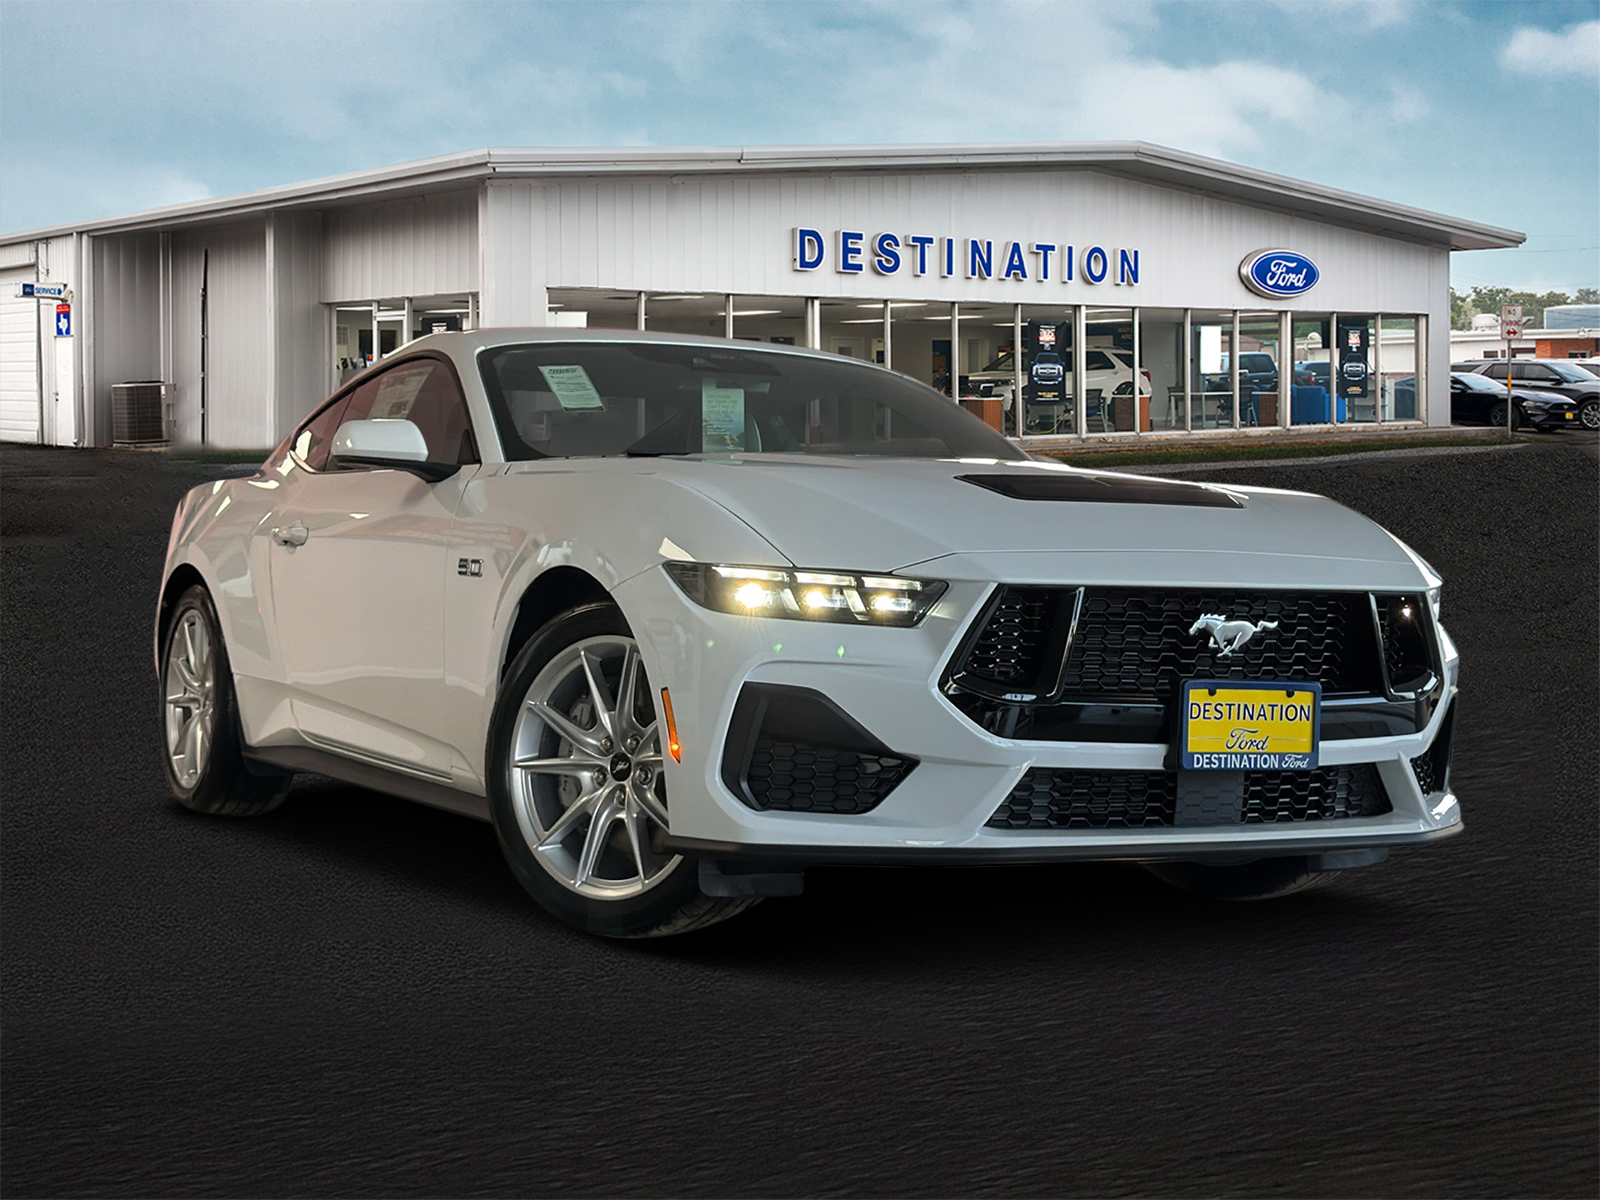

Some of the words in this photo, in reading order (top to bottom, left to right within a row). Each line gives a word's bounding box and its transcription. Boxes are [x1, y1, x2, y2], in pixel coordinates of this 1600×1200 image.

[793, 227, 1141, 286] DESTINATION
[1266, 259, 1307, 287] Ford
[35, 286, 57, 295] SERVICE
[1189, 702, 1311, 722] DESTINATION
[1225, 727, 1270, 751] Ford
[1193, 754, 1279, 769] DESTINATION
[1281, 753, 1310, 769] Ford
